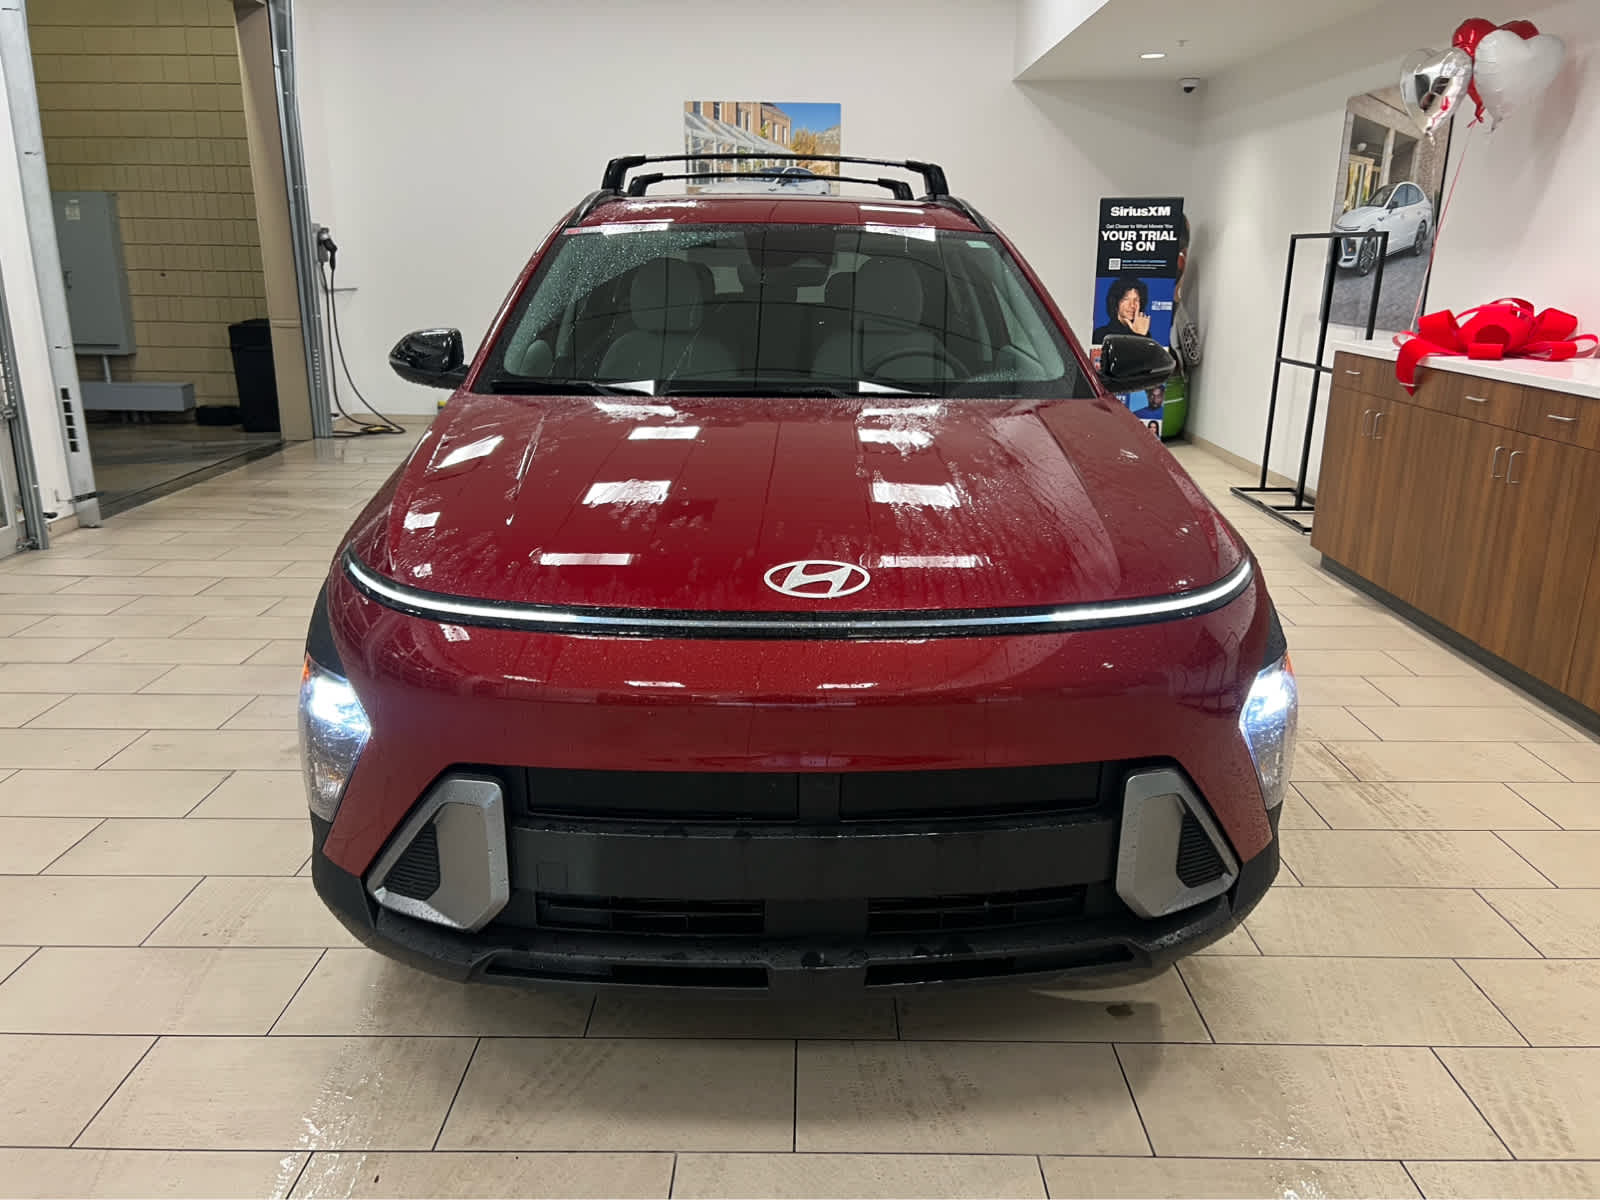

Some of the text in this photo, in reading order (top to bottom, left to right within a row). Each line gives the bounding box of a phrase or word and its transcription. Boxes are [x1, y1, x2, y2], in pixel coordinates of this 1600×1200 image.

[1110, 206, 1172, 217] SiriusXM
[1101, 230, 1177, 241] YOUR TRIAL
[1120, 241, 1156, 252] IS ON
